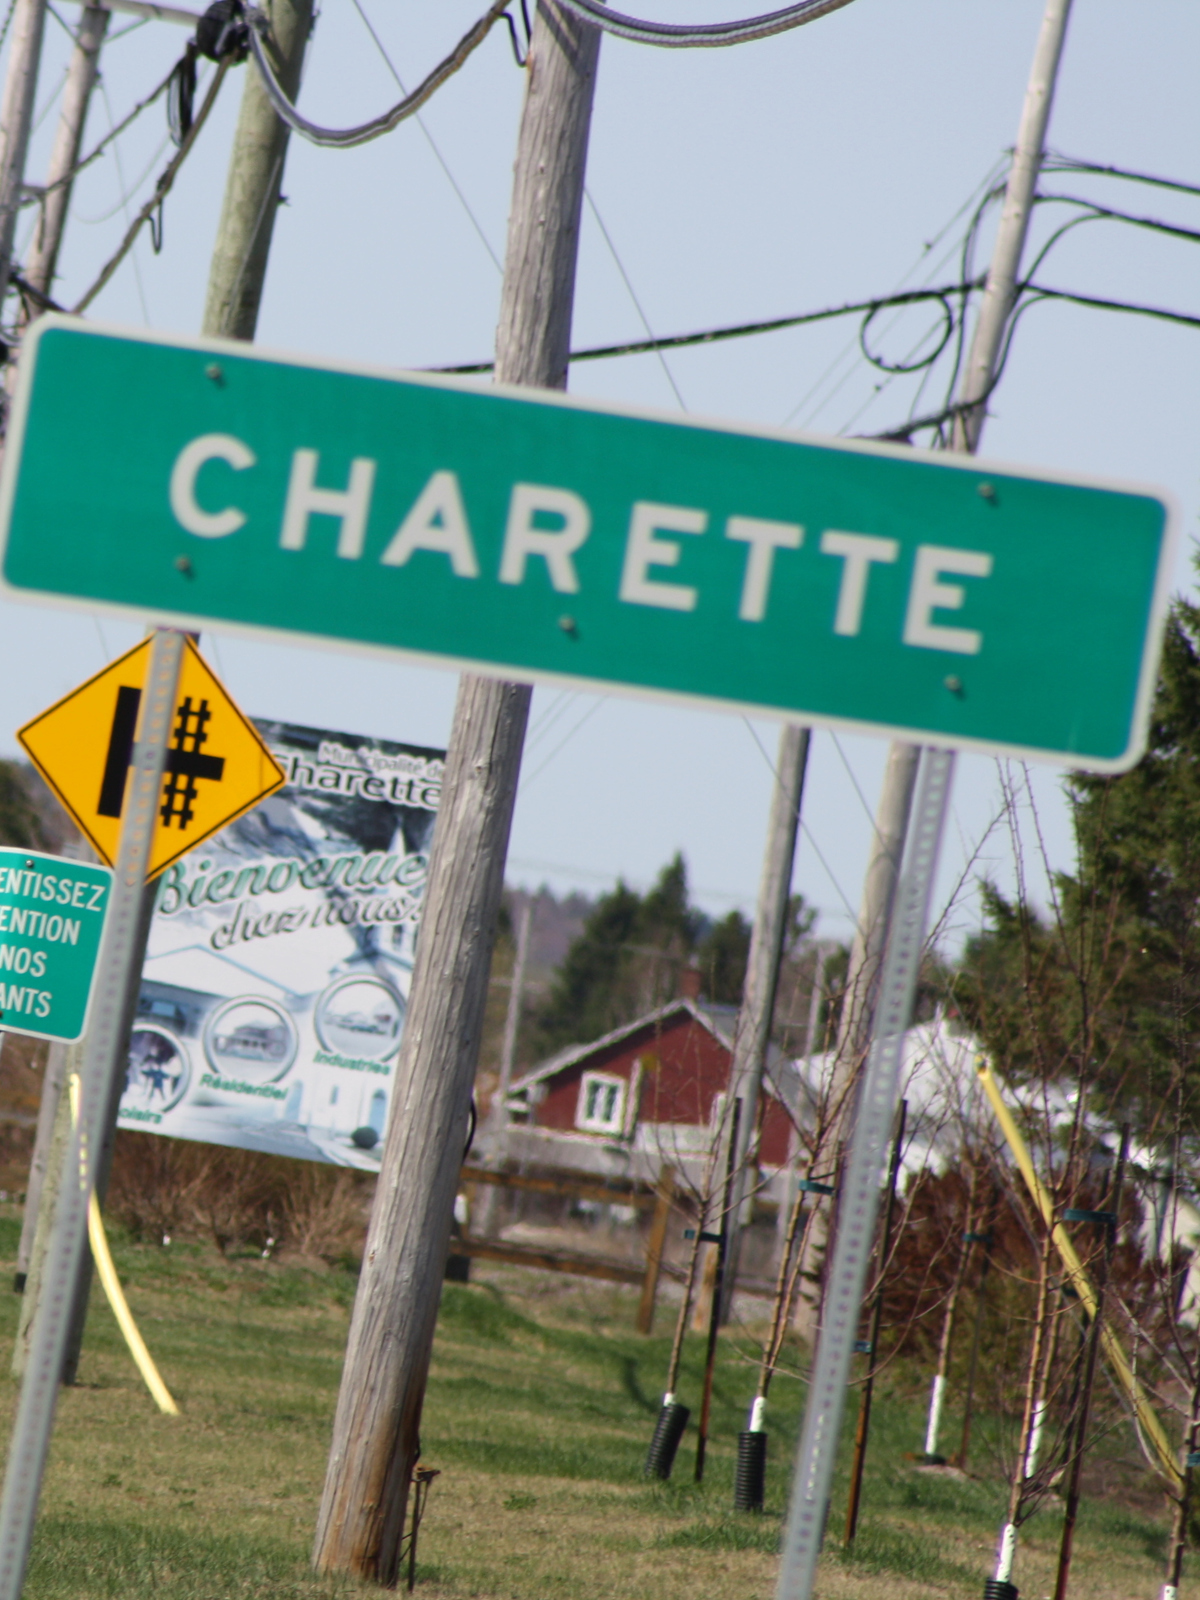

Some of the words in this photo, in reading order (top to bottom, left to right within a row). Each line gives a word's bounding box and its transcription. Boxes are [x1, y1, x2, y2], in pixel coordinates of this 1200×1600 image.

[169, 433, 993, 654] CHARETTE
[157, 853, 427, 914] Bienvenue
[211, 899, 308, 950] chez
[314, 1050, 391, 1076] Industries
[118, 1106, 163, 1124] oisirs
